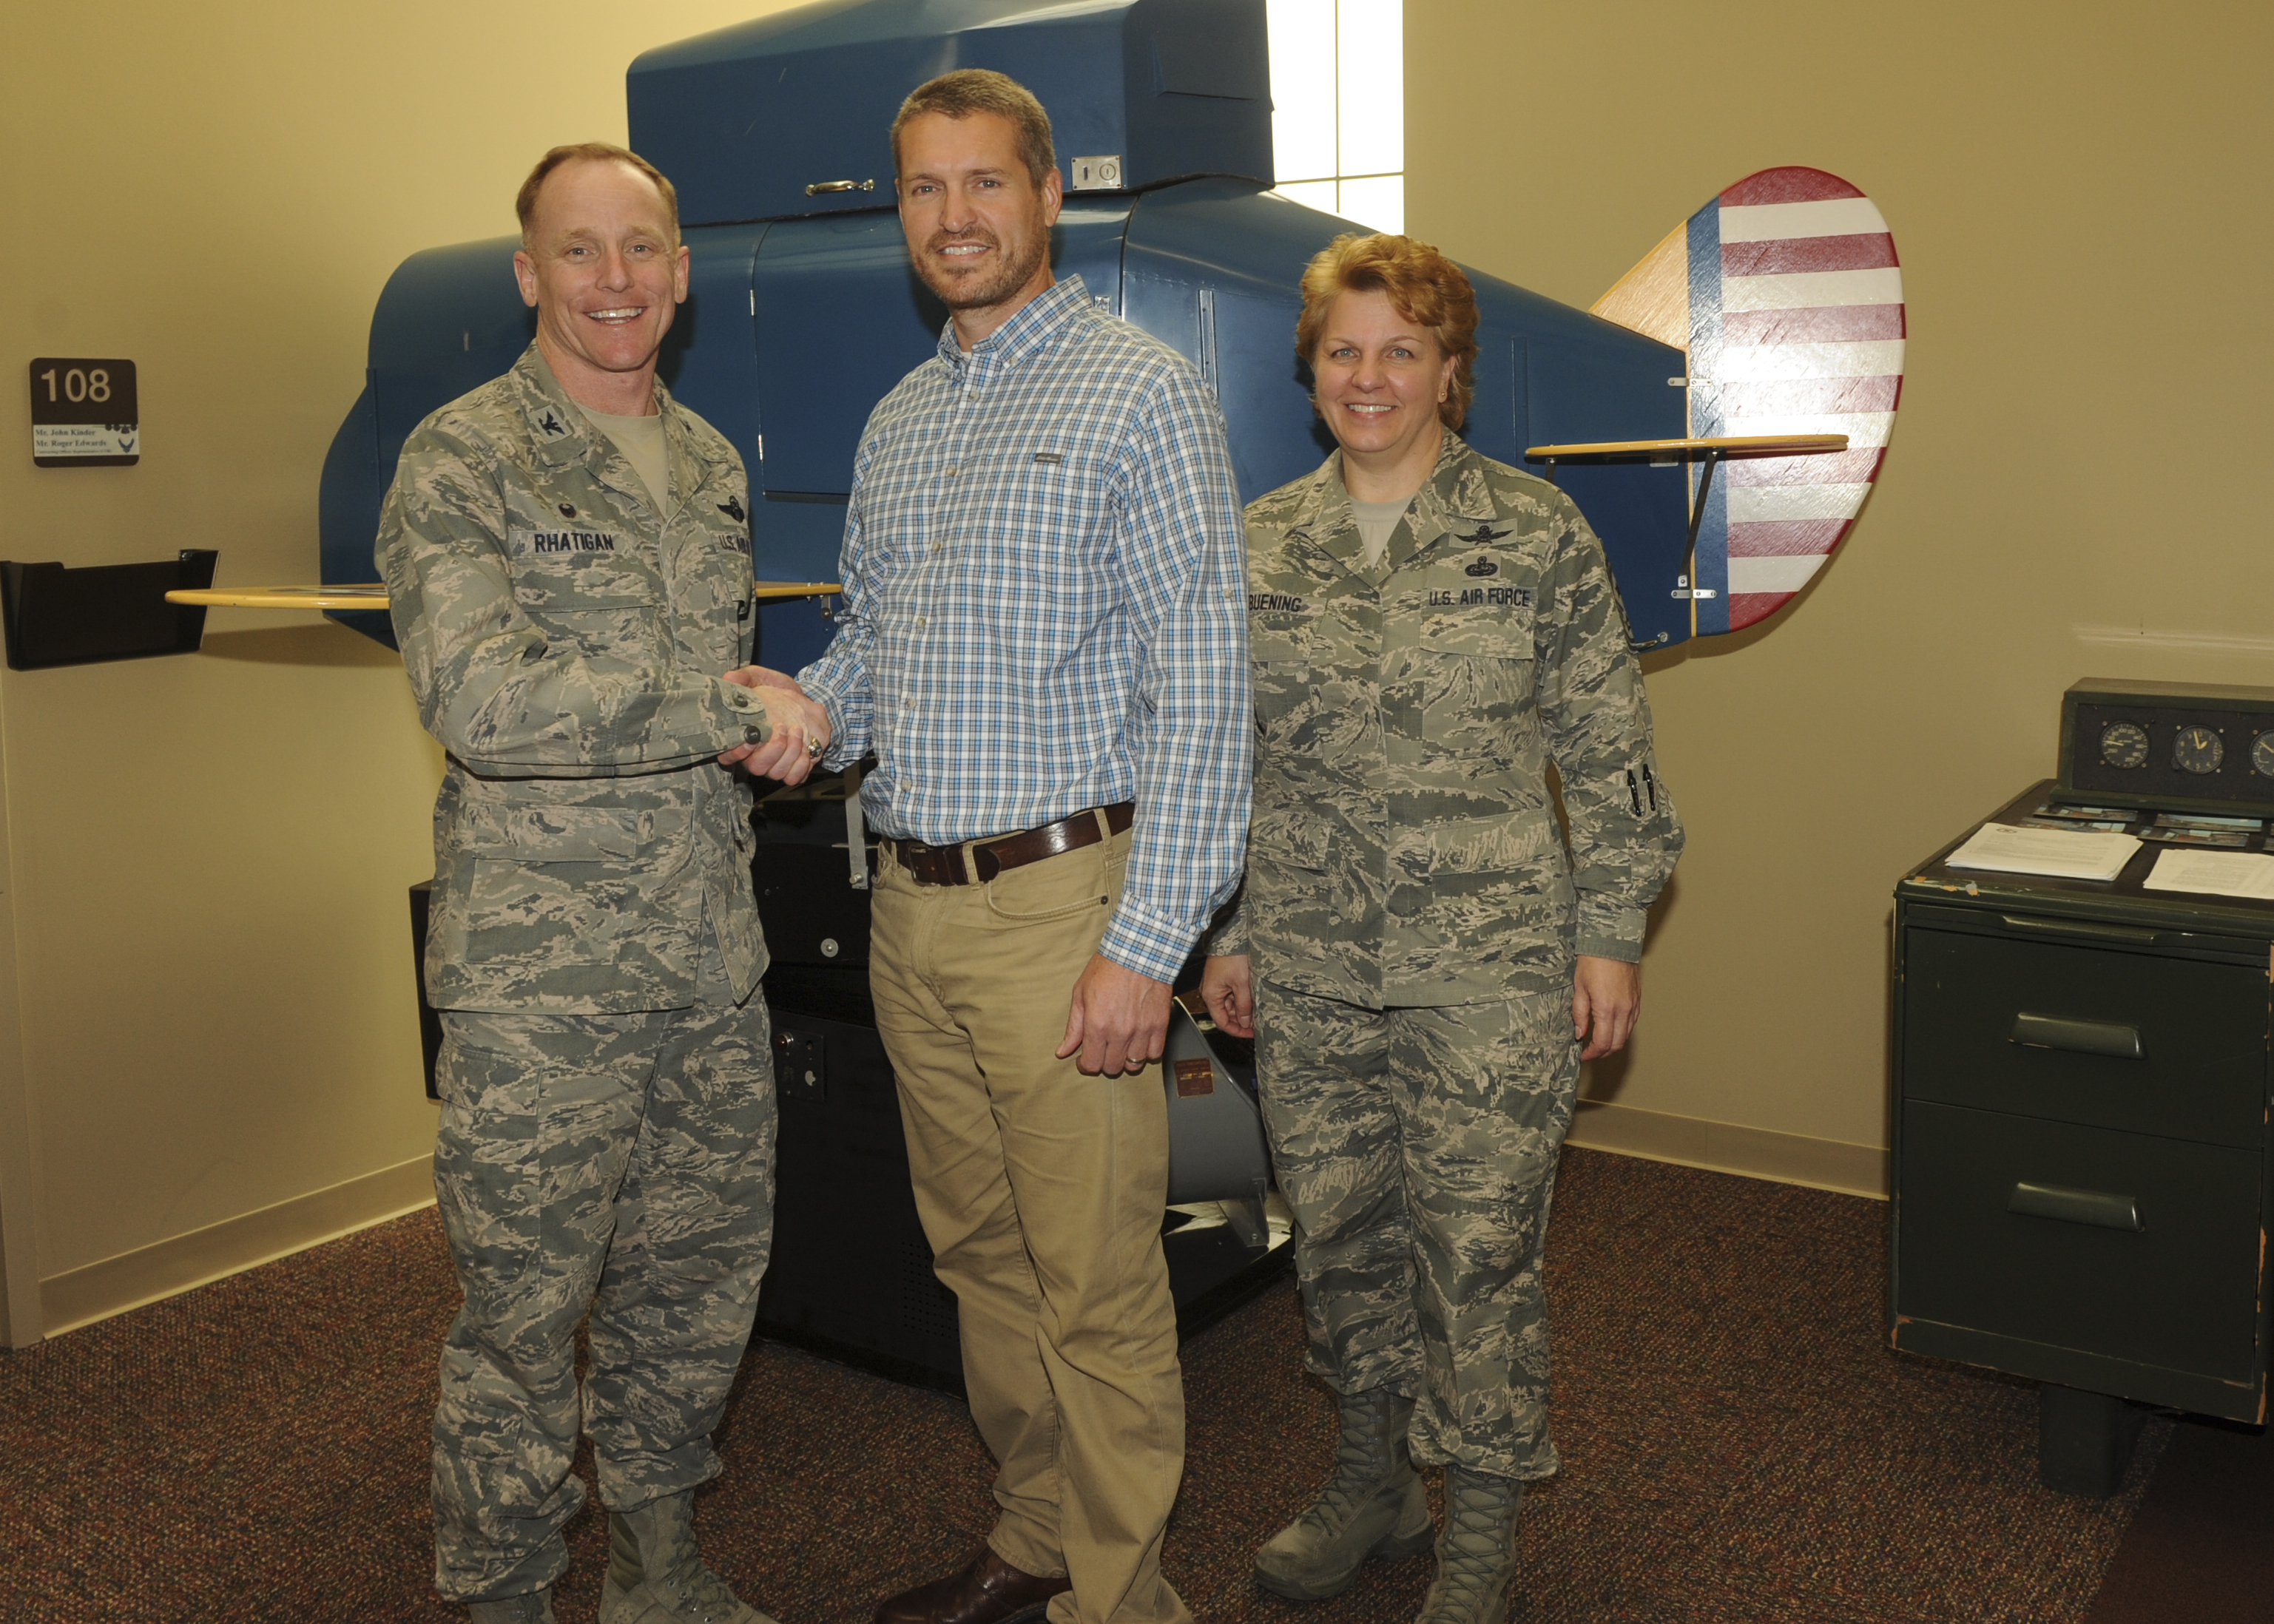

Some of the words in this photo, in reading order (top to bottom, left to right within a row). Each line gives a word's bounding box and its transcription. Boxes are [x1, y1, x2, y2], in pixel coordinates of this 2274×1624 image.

[41, 368, 111, 402] 108
[51, 439, 72, 447] Roger
[534, 532, 614, 553] RHATIGAN
[1429, 590, 1455, 606] U.S.
[1460, 589, 1483, 606] AIR
[1488, 587, 1530, 607] FORCE
